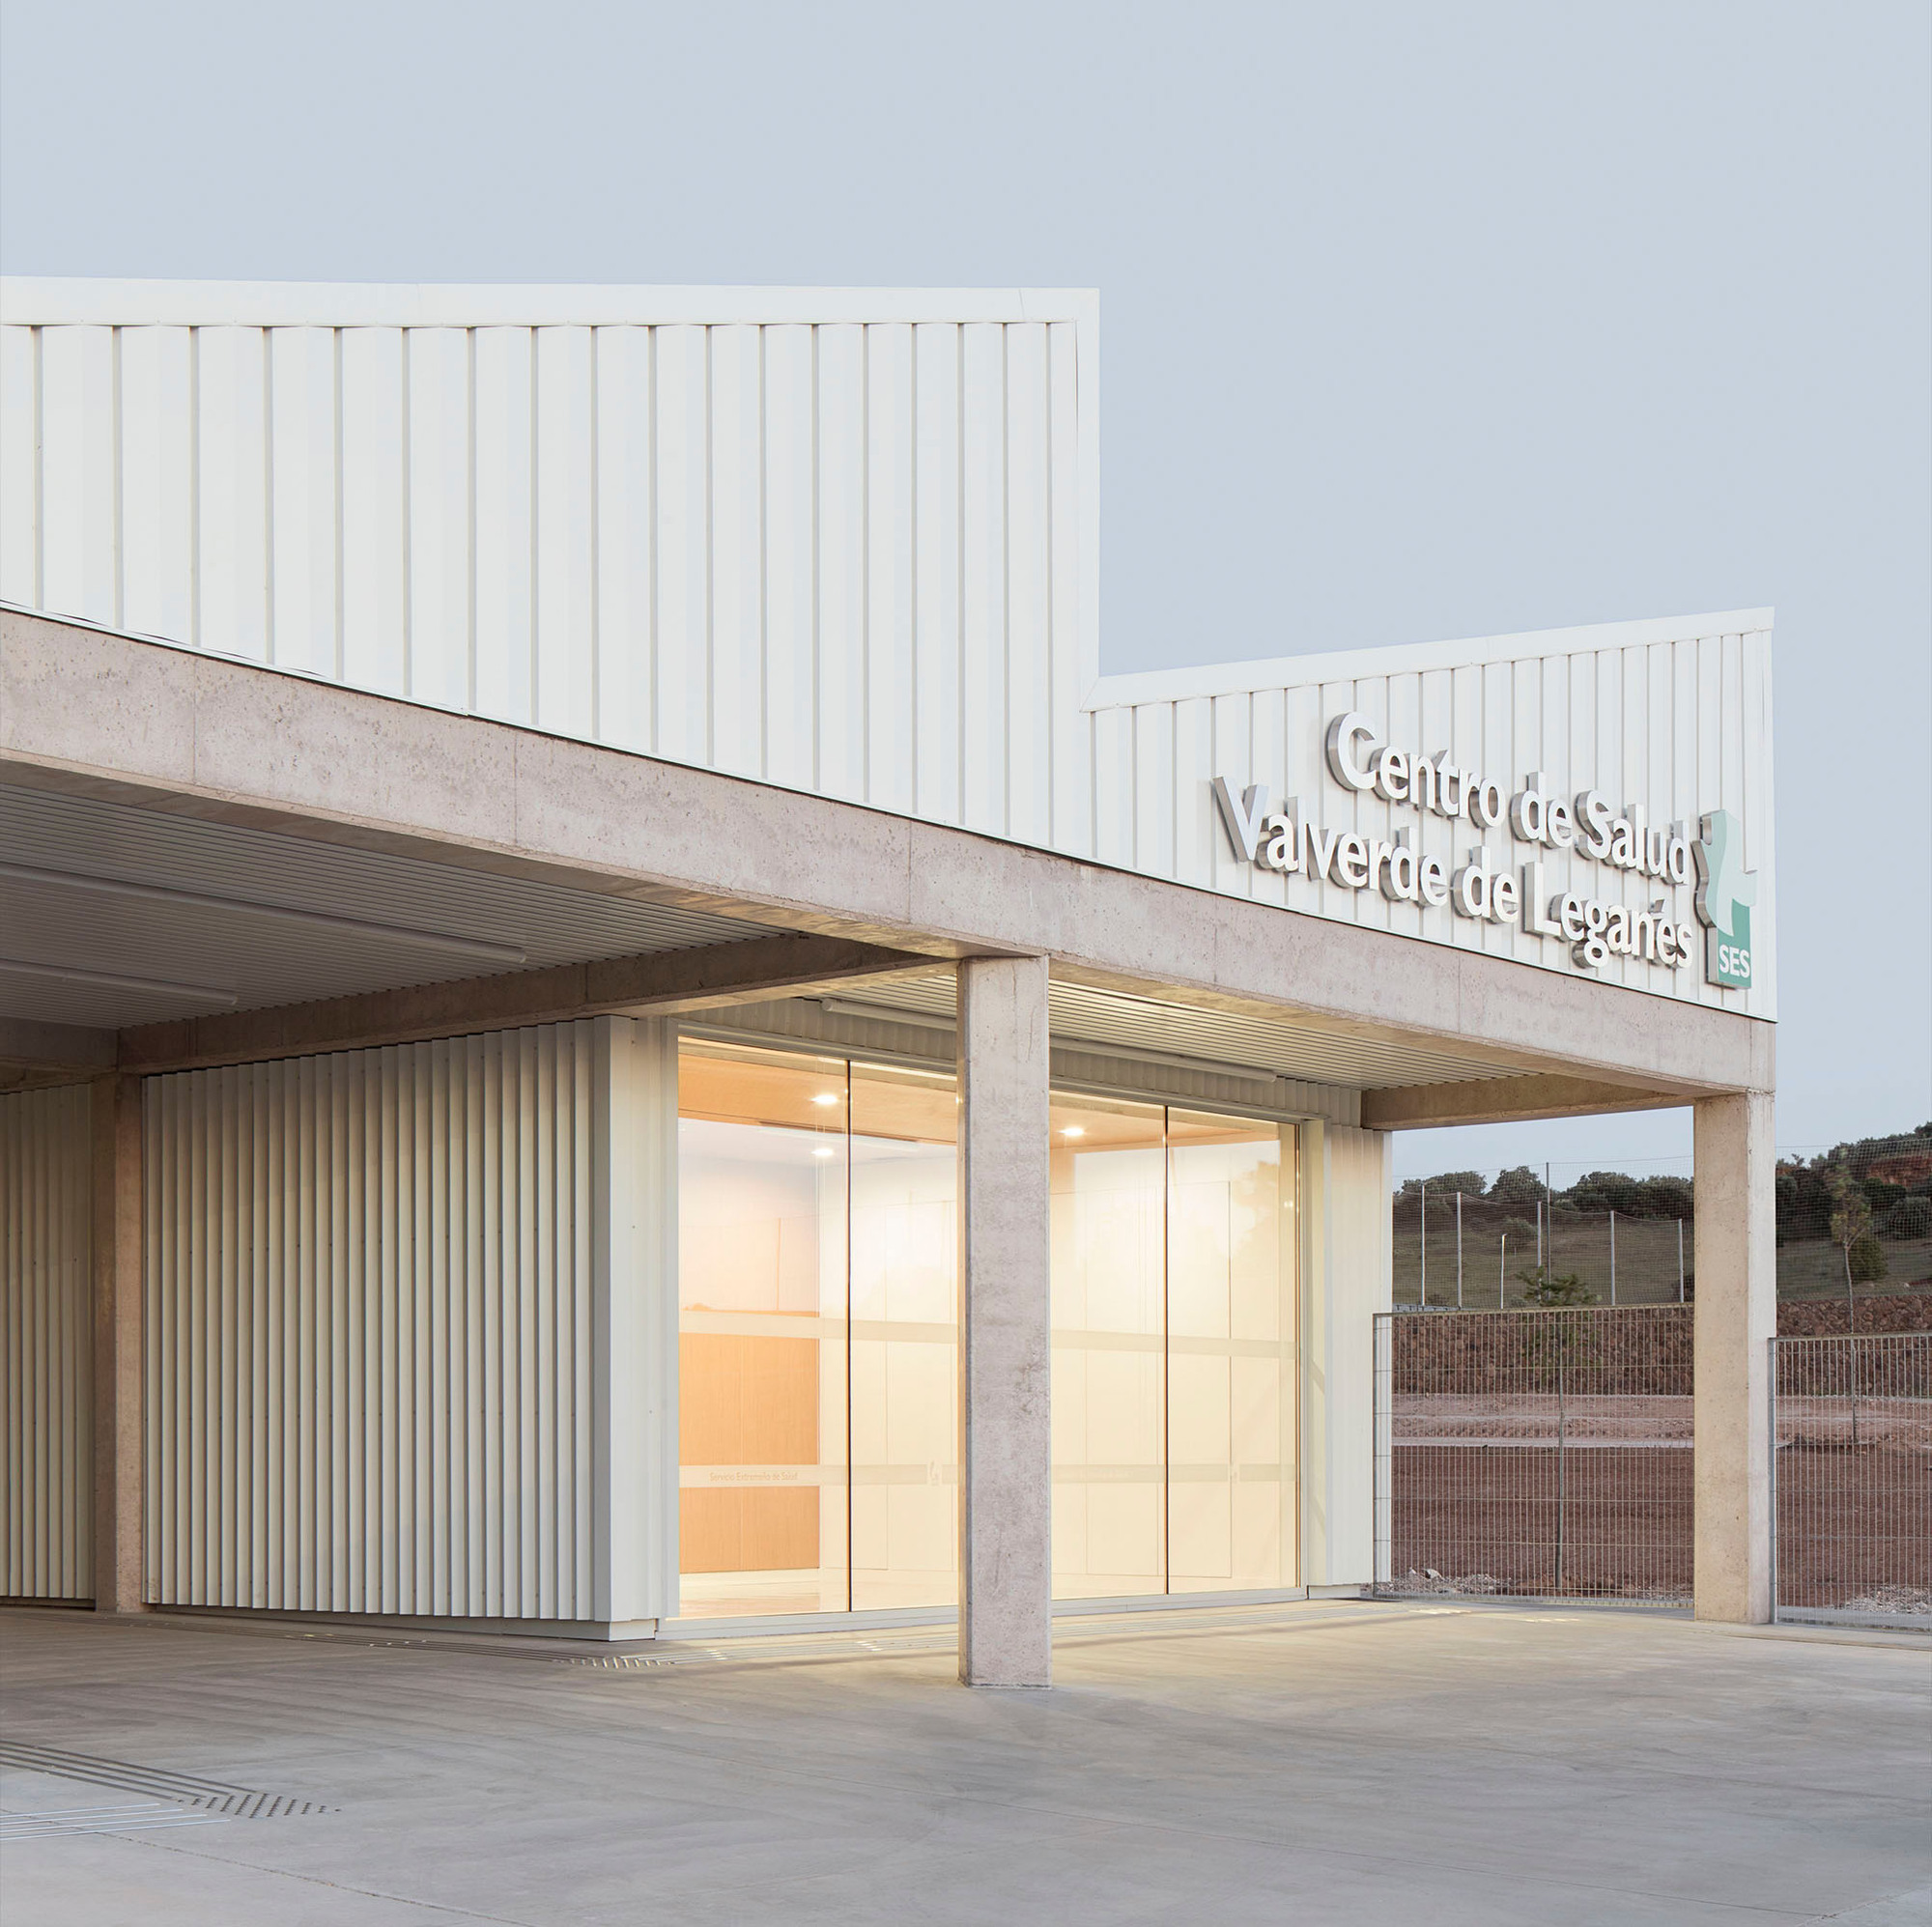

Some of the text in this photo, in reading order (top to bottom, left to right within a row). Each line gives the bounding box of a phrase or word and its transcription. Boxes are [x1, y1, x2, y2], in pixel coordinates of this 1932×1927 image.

[1214, 777, 1694, 968] Valverde de Leganés
[1327, 713, 1690, 885] Centro de Salud
[1719, 943, 1751, 978] SES
